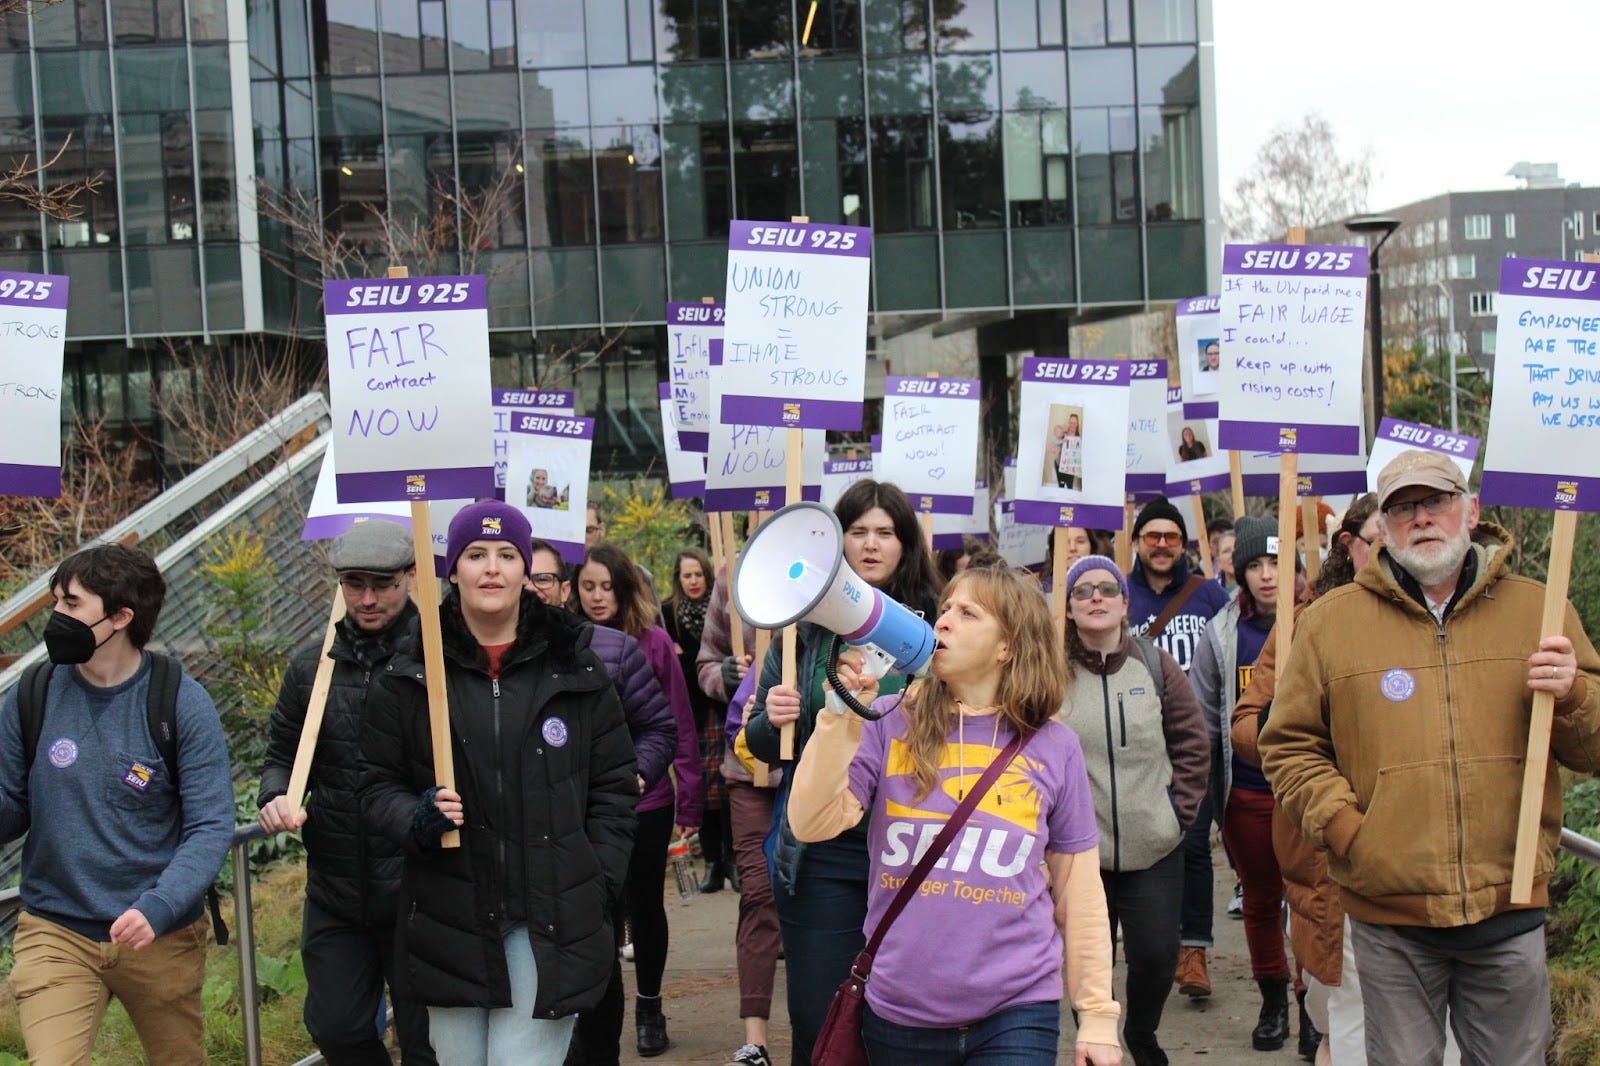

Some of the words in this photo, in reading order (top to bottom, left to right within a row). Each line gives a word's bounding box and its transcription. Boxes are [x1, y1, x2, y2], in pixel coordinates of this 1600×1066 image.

[748, 227, 806, 247] SEIU
[811, 230, 857, 250] 925
[1241, 250, 1299, 270] SEIU
[1305, 252, 1353, 271] 925
[733, 263, 801, 292] UNION
[1522, 267, 1596, 292] SEIU
[0, 279, 52, 300] 925
[347, 285, 410, 306] SEIU
[418, 283, 469, 305] 925
[1252, 280, 1271, 293] the
[1277, 280, 1300, 295] UW
[1304, 283, 1329, 301] paid
[1336, 287, 1351, 298] me
[1356, 290, 1362, 299] a
[677, 307, 709, 321] SEIU
[760, 295, 842, 319] STRONG
[1187, 299, 1220, 312] SEIU
[1239, 304, 1288, 323] FAIR
[1300, 304, 1353, 323] WAGE
[0, 322, 58, 338] TRONG
[1224, 328, 1237, 342] I
[346, 323, 448, 369] FAIR
[730, 343, 800, 363] IHME
[1525, 338, 1556, 353] ARE
[1567, 339, 1597, 355] THE
[1035, 363, 1077, 379] SEIU
[1081, 364, 1119, 381] 925
[1236, 357, 1271, 375] Keep
[1280, 363, 1296, 376] up
[1303, 363, 1332, 374] with
[1523, 364, 1560, 384] THAT
[367, 372, 436, 391] contract
[770, 368, 848, 386] STRONG
[0, 383, 57, 399] TRONG
[897, 380, 936, 393] SEIU
[940, 382, 970, 395] 925
[1241, 382, 1281, 400] rising
[502, 392, 536, 404] SEIU
[538, 394, 566, 405] 925
[1532, 392, 1553, 408] PAY
[1561, 396, 1580, 409] US
[893, 401, 932, 420] FAIR
[1542, 412, 1561, 425] WE
[348, 406, 438, 437] NOW
[521, 416, 554, 431] SEIU
[556, 420, 585, 434] 925
[896, 424, 958, 441] CONTRACT
[1390, 424, 1432, 444] SEIU
[1433, 434, 1468, 452] 925
[721, 449, 785, 476] NOW
[831, 462, 857, 472] SEIU
[481, 527, 502, 535] SEIU
[126, 774, 147, 787] SEIU
[881, 821, 1036, 878] SEIU
[880, 872, 948, 896] Strger
[953, 880, 1026, 905] Together
